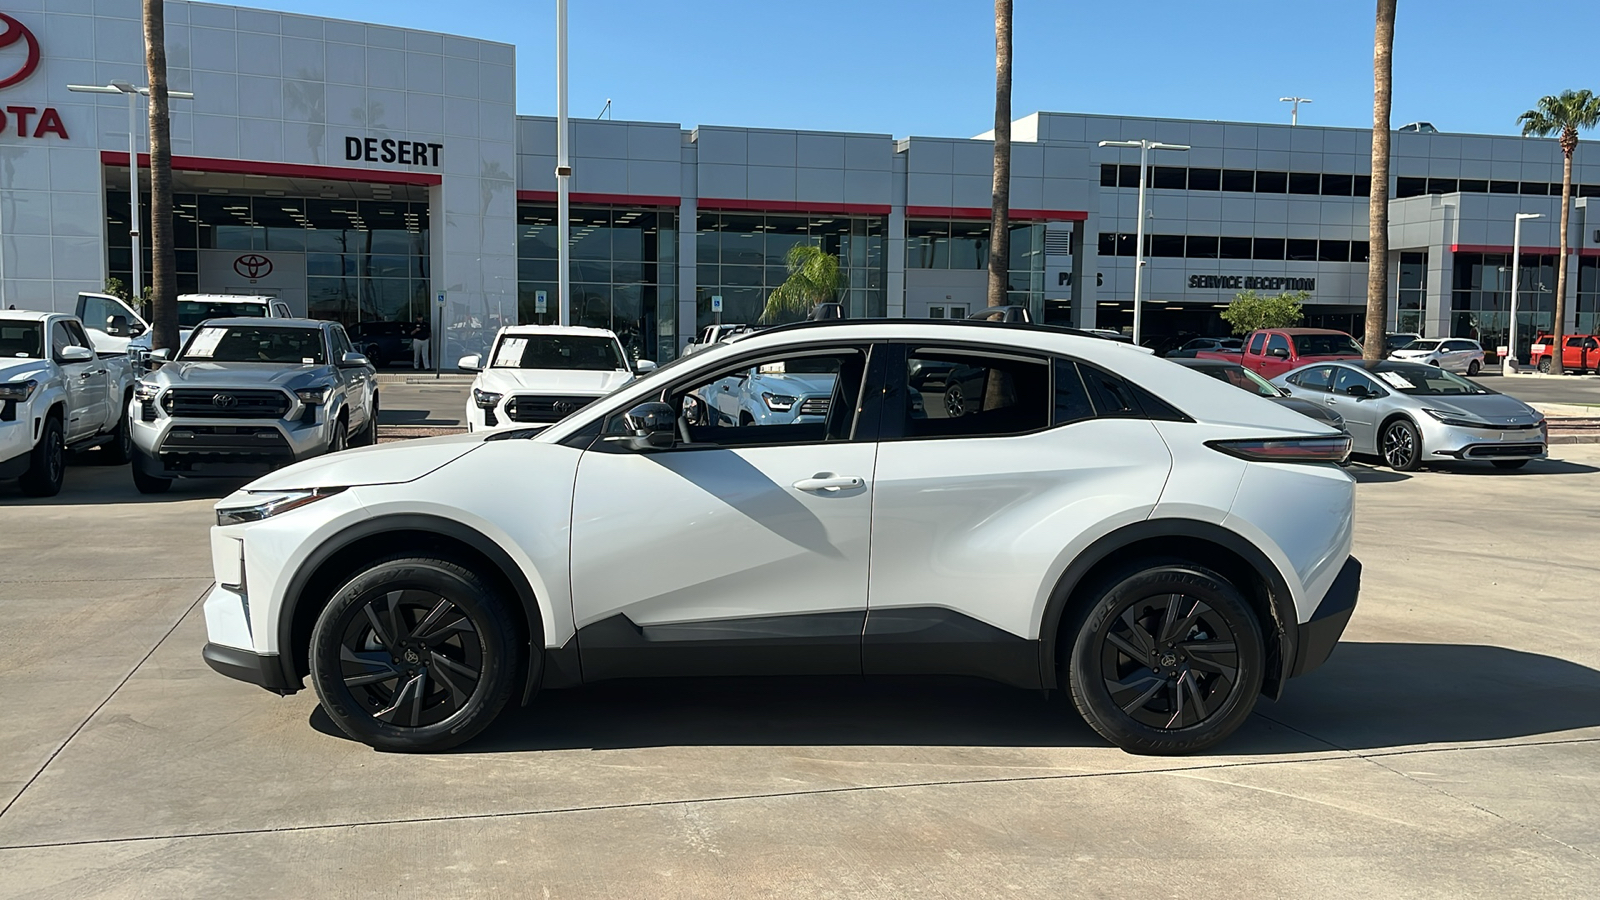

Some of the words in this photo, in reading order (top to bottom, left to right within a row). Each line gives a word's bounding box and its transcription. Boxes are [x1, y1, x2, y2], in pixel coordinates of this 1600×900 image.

[0, 106, 69, 139] TA
[345, 136, 443, 166] DESERT
[1058, 272, 1103, 287] PAS
[1188, 274, 1243, 289] SERVICE
[1244, 276, 1316, 291] RECEPTION
